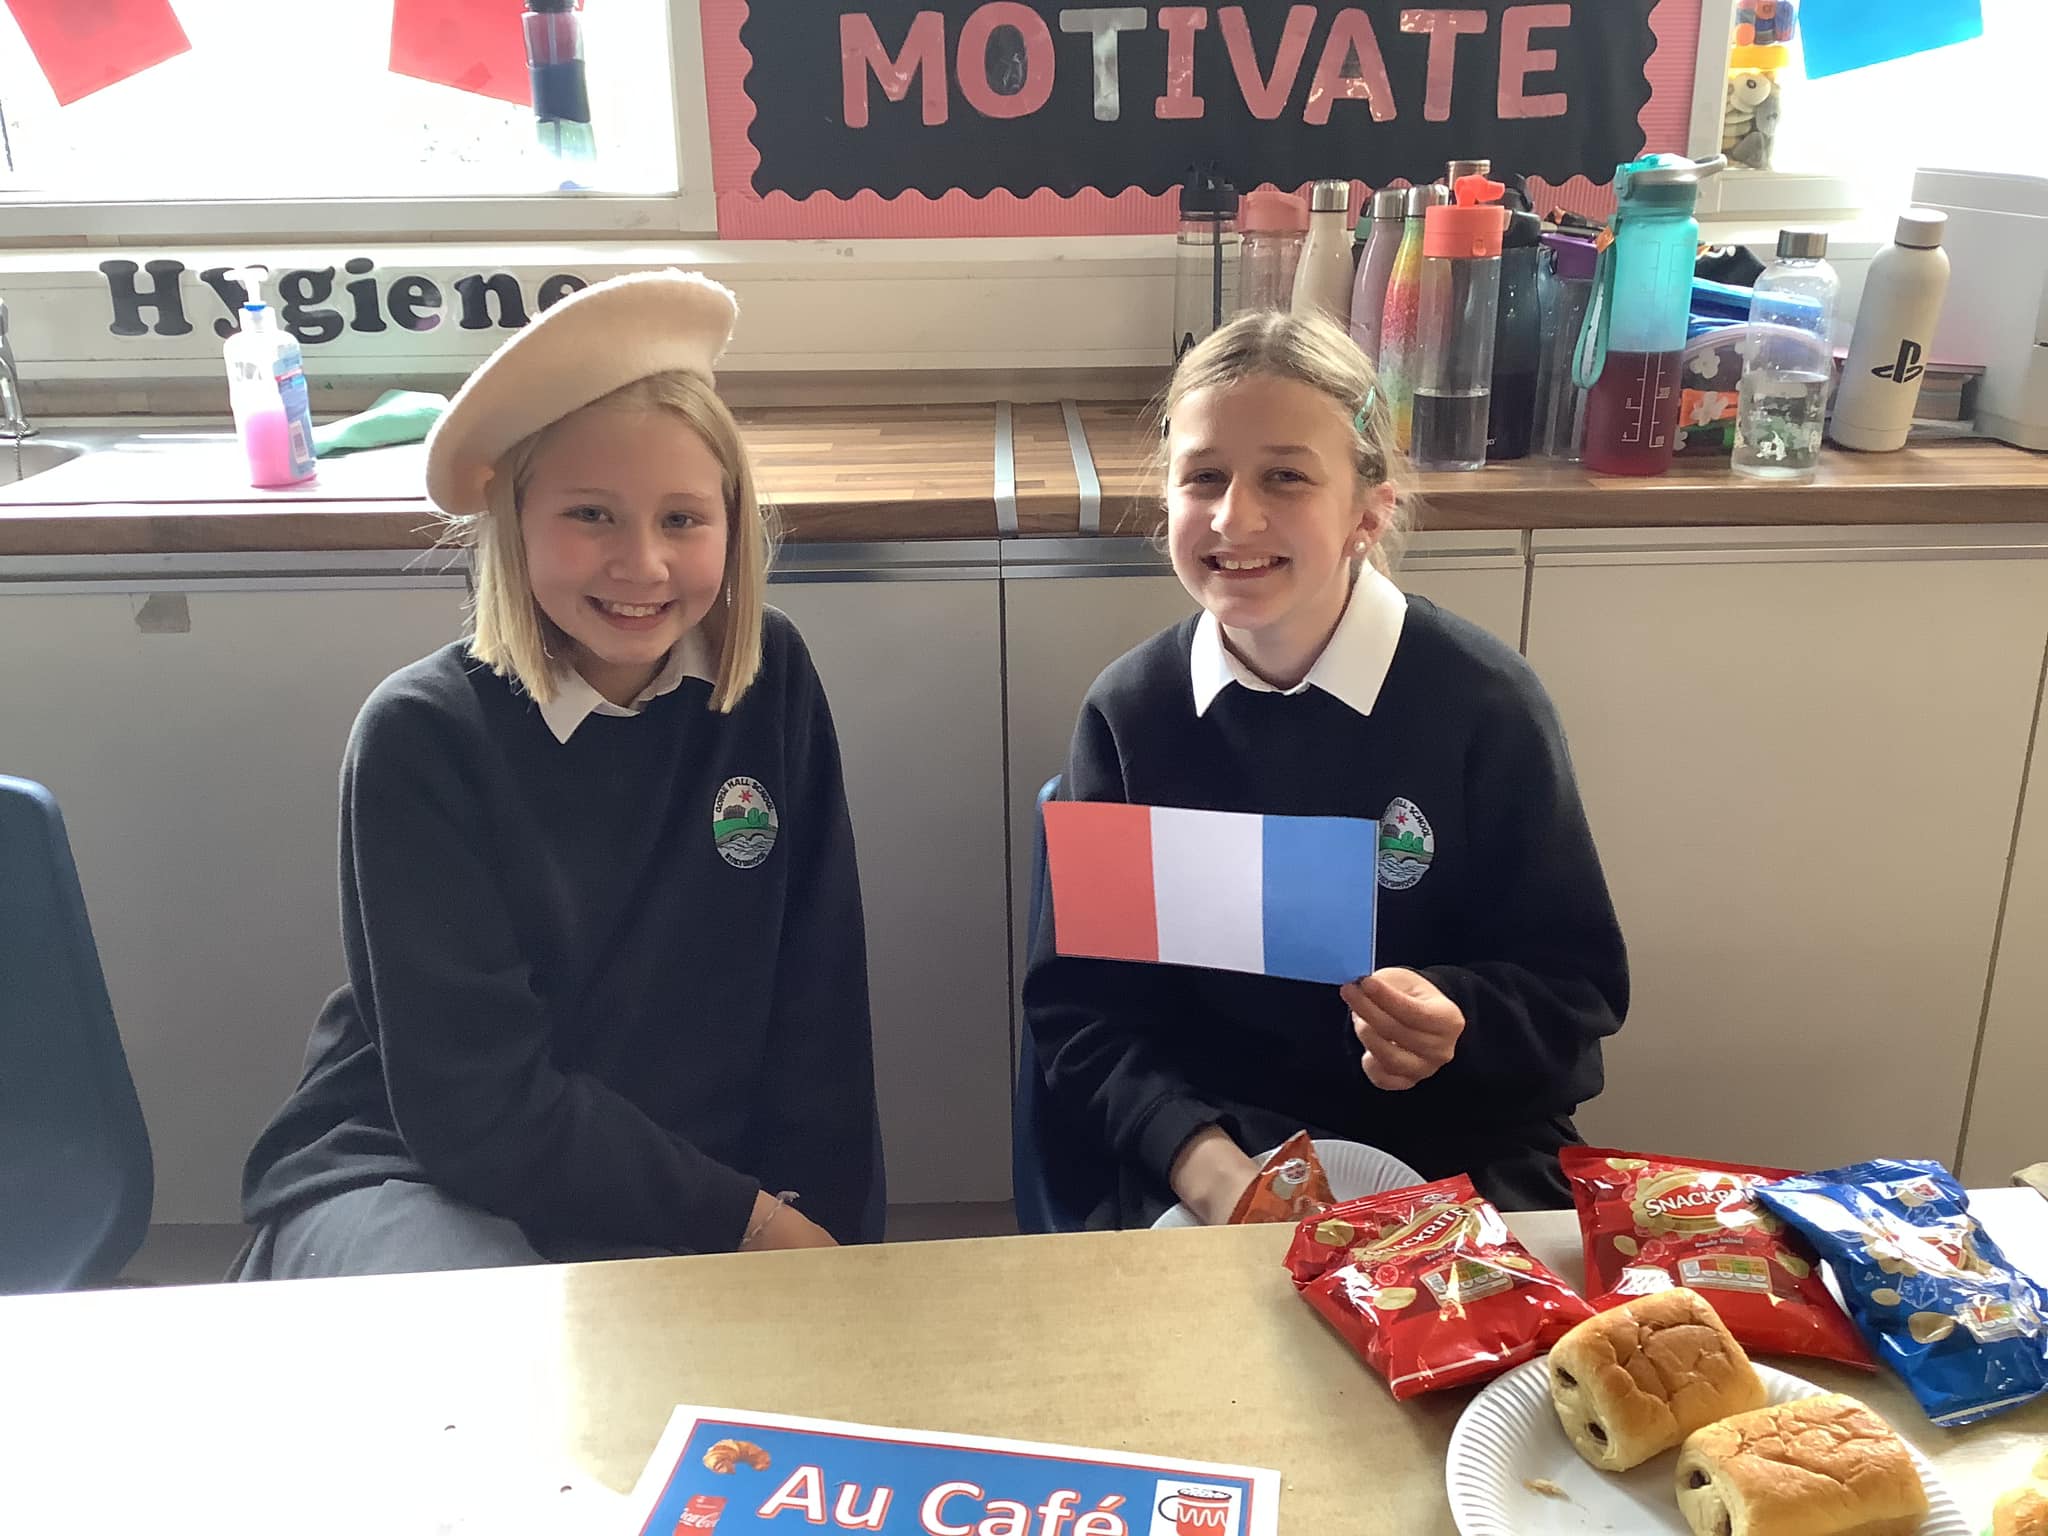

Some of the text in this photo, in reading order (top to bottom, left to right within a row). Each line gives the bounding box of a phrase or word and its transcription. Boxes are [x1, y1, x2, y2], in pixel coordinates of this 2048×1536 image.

[839, 2, 1571, 127] MOTIVATE
[751, 781, 775, 812] SCHOOL
[1645, 1188, 1755, 1217] SNACKR
[757, 1465, 1129, 1536] Au Café
